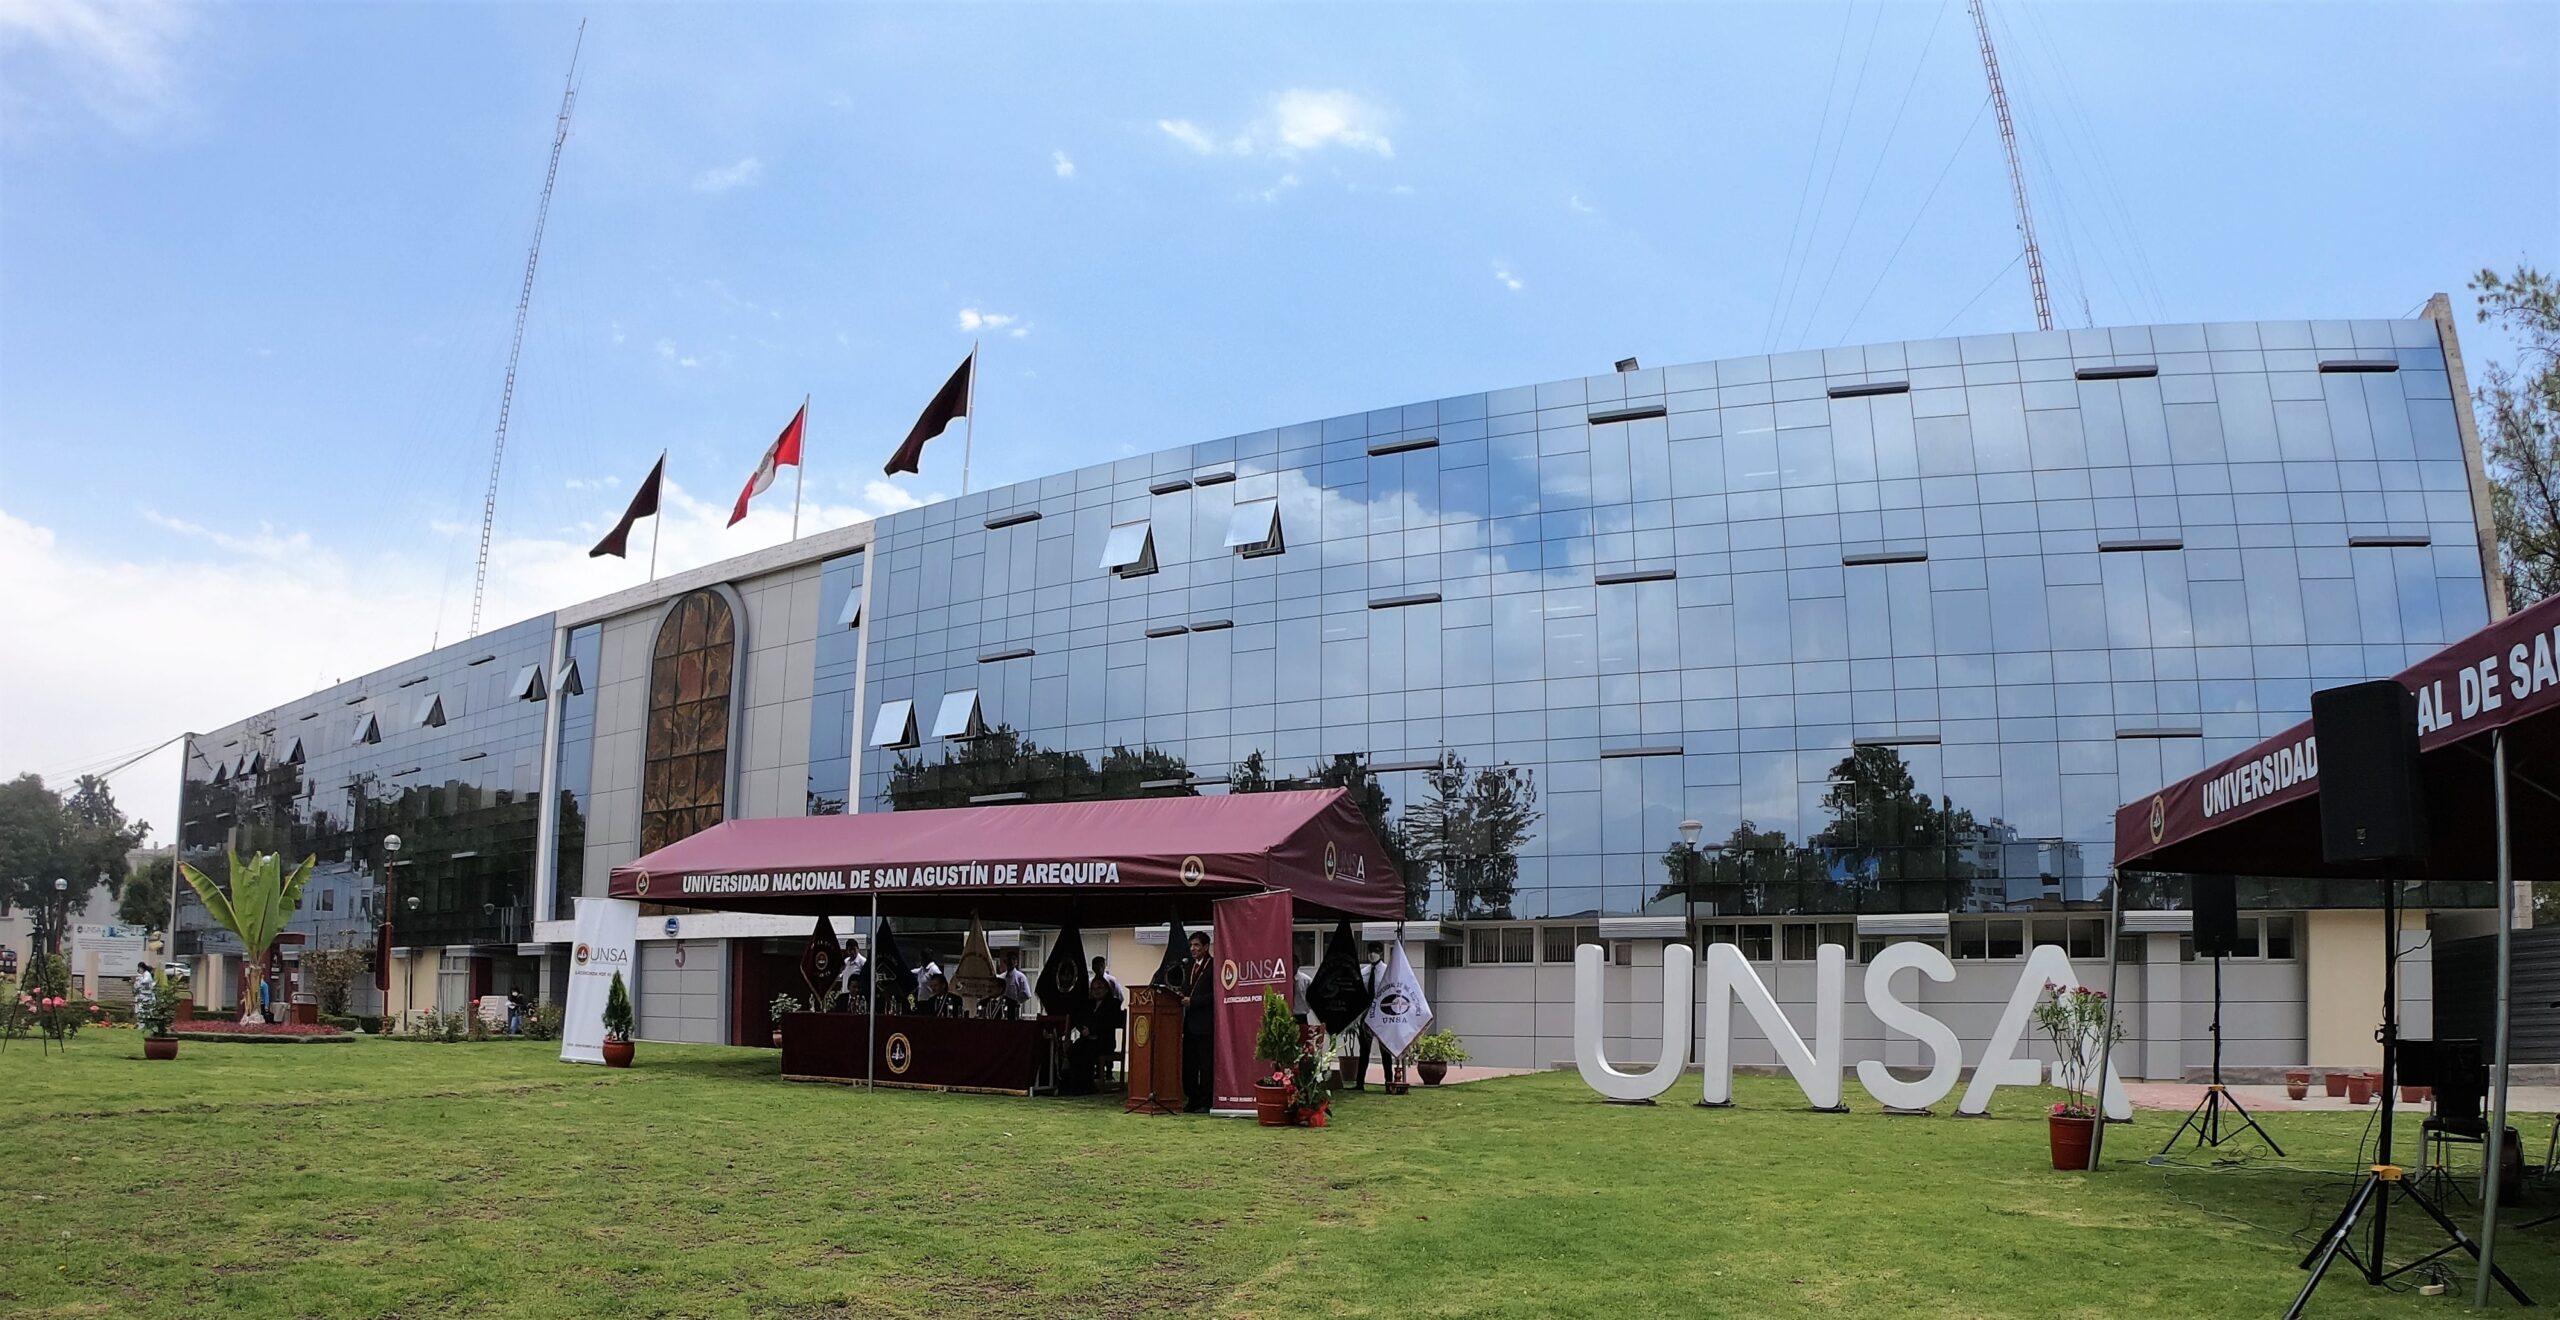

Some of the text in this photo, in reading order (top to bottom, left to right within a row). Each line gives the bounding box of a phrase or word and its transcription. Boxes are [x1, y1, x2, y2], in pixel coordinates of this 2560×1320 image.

[2203, 736, 2319, 818] UNIVERSIDAD
[2417, 679, 2453, 737] AL
[2458, 655, 2502, 720] DE
[682, 861, 1120, 893] UNIVERSIDAD NACIONAL DE SAN AGUSTÍN DE AREQUIPA
[590, 946, 628, 963] UNSA
[674, 943, 686, 969] 5
[1238, 957, 1287, 981] UNSA
[1382, 1016, 1408, 1024] UNSA
[1574, 941, 2133, 1121] UNSA
